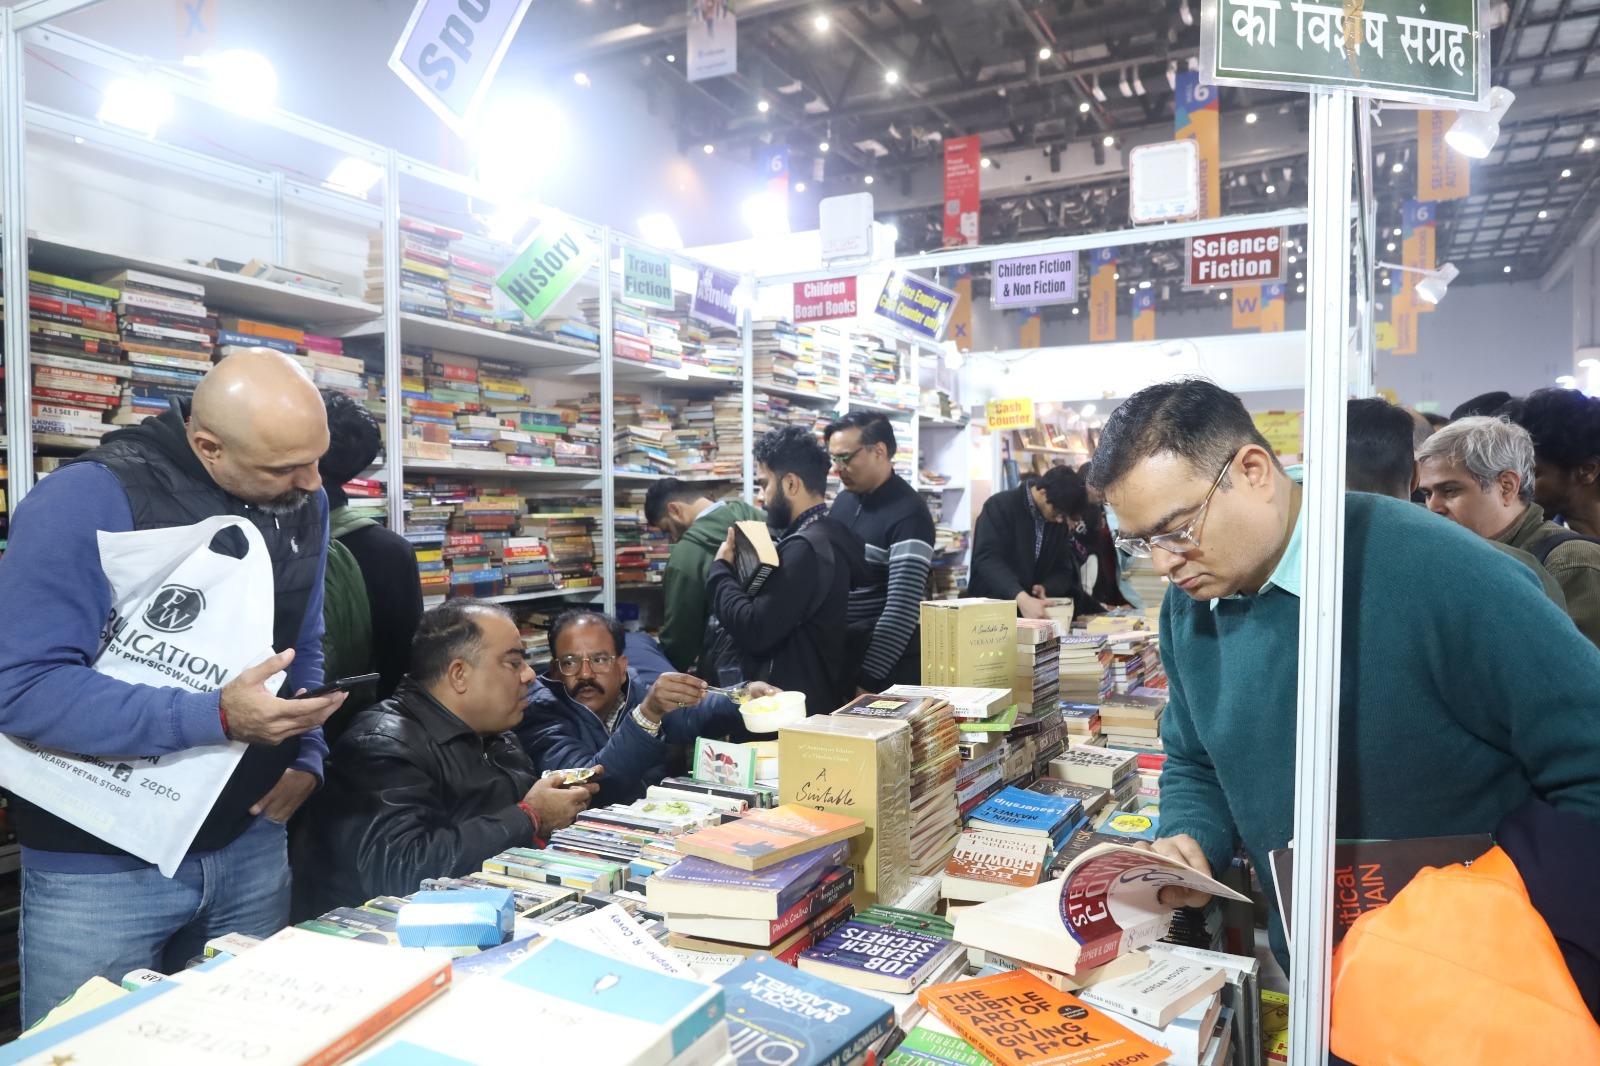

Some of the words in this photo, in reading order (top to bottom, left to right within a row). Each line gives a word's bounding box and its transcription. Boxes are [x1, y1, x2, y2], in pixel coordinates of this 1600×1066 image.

[1396, 3, 1469, 76] संग्रह
[1194, 83, 1209, 101] 6
[771, 154, 782, 172] 6
[1199, 158, 1208, 217] UMANITIES
[1416, 206, 1428, 221] 6
[1102, 248, 1111, 260] 6
[1193, 235, 1279, 259] Science
[507, 233, 580, 307] History
[628, 254, 667, 279] Travel
[998, 262, 1036, 279] Children
[1039, 259, 1072, 275] Fiction
[1199, 258, 1272, 280] Fiction
[625, 276, 671, 300] Fiction
[804, 280, 846, 298] Children
[1003, 282, 1011, 297] &
[1013, 281, 1031, 297] Non
[1034, 279, 1066, 295] Fiction
[795, 300, 824, 319] Board
[825, 298, 856, 315] Books
[914, 289, 940, 312] Enquiry
[1236, 298, 1258, 314] W
[896, 301, 926, 325] Counter
[923, 315, 940, 332] only
[954, 323, 967, 338] X
[42, 406, 52, 414] AS
[59, 408, 71, 416] SEE
[995, 402, 1022, 415] Cash
[989, 413, 1031, 428] Counter
[108, 643, 123, 656] BY
[1055, 756, 1118, 768] POWER
[1065, 750, 1126, 762] STORY
[40, 751, 73, 771] NEARBY
[73, 766, 98, 785] RETAIL
[99, 779, 131, 798] STORES
[815, 768, 827, 782] A
[140, 777, 181, 802] zepto
[796, 782, 855, 806] Suitable
[986, 805, 1039, 820] MAXWELL
[994, 798, 1062, 815] Leadership
[996, 814, 1021, 824] JOHN
[969, 834, 1037, 850] Friedman
[981, 841, 1040, 856] Thomas
[953, 849, 1038, 870] CROWDED
[608, 912, 633, 937] Covey
[631, 933, 644, 948] R.
[840, 927, 935, 953] SECRETS
[642, 944, 679, 976] Stephen
[693, 955, 735, 963] DANIEL
[838, 939, 924, 963] SEARCH
[1078, 947, 1097, 964] STEPHEN
[1103, 940, 1118, 956] COVEY
[1186, 950, 1228, 960] OBAMA
[864, 956, 913, 976] JOB
[239, 968, 363, 999] GLADWELL
[1140, 979, 1167, 994] MORGAN
[1165, 965, 1190, 981] HOUSEL
[208, 981, 337, 1016] MALCOLM
[740, 980, 838, 1023] MALCOLM
[753, 972, 852, 1016] GLADWELL
[939, 990, 990, 1004] THE
[953, 991, 1044, 1015] SUBTLE
[1083, 992, 1104, 1002] MORGAN
[1104, 999, 1124, 1010] HOUSEL
[971, 1009, 1016, 1027] ART
[1020, 1001, 1052, 1015] OF
[979, 1019, 1032, 1037] NOT
[996, 1022, 1082, 1047] GIVING
[128, 1020, 271, 1061] OUTLIERS
[842, 1027, 884, 1061] GLADWELL
[920, 1031, 968, 1050] MERRILL
[952, 1022, 968, 1039] SUBTLE
[969, 1035, 978, 1046] ART
[985, 1049, 995, 1060] NOT
[930, 1044, 978, 1064] MERRILL
[1013, 1047, 1035, 1060] A
[1031, 1048, 1093, 1066] COUNTERINTUITIVE
[1093, 1038, 1127, 1052] APPROACH
[1101, 1052, 1149, 1066] NSON
